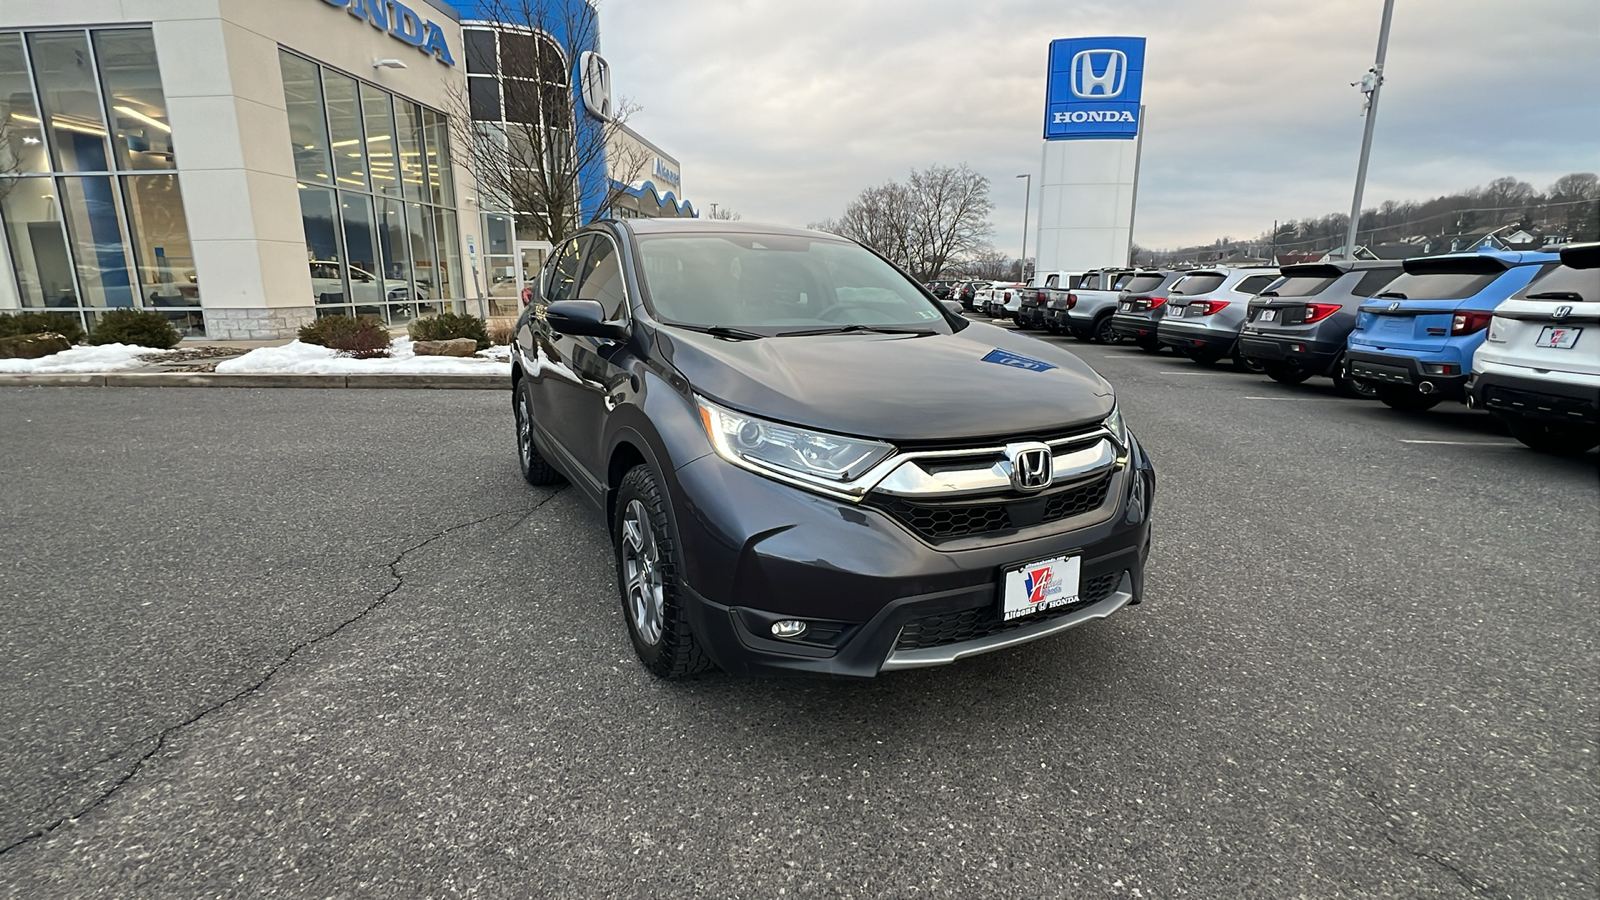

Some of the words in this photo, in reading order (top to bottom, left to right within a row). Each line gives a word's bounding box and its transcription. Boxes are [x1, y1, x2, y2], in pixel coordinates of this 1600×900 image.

[318, 0, 455, 66] NDA
[1052, 110, 1136, 124] HONDA
[1004, 606, 1036, 621] Altoona
[1049, 595, 1080, 608] HONDA
